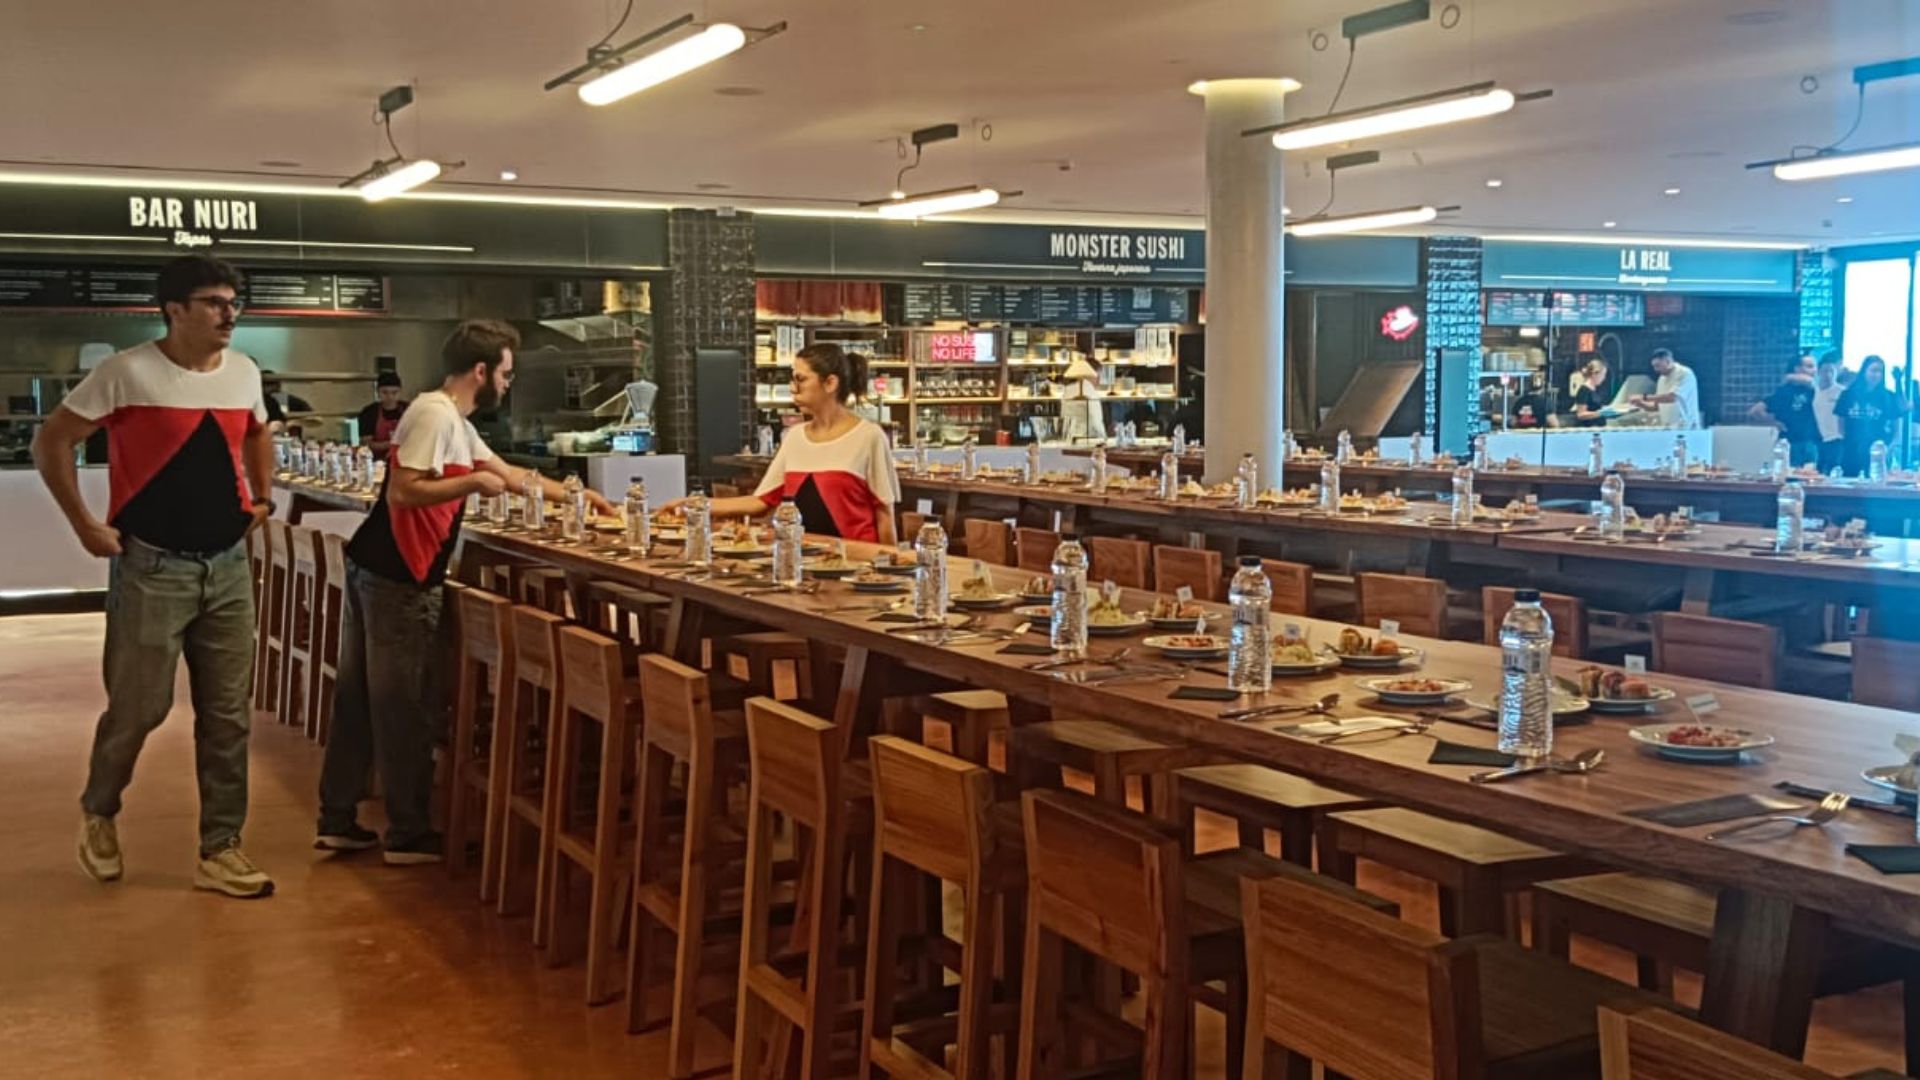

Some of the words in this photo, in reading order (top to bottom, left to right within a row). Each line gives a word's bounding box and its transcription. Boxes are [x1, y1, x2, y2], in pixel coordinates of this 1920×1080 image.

[129, 196, 184, 228] BAR
[194, 198, 257, 230] NURI
[1050, 232, 1131, 259] MONSTER
[1136, 235, 1185, 260] SUSHI
[1620, 249, 1636, 271] LA
[1640, 250, 1672, 271] REAL
[931, 334, 950, 347] NO
[931, 347, 950, 360] NO
